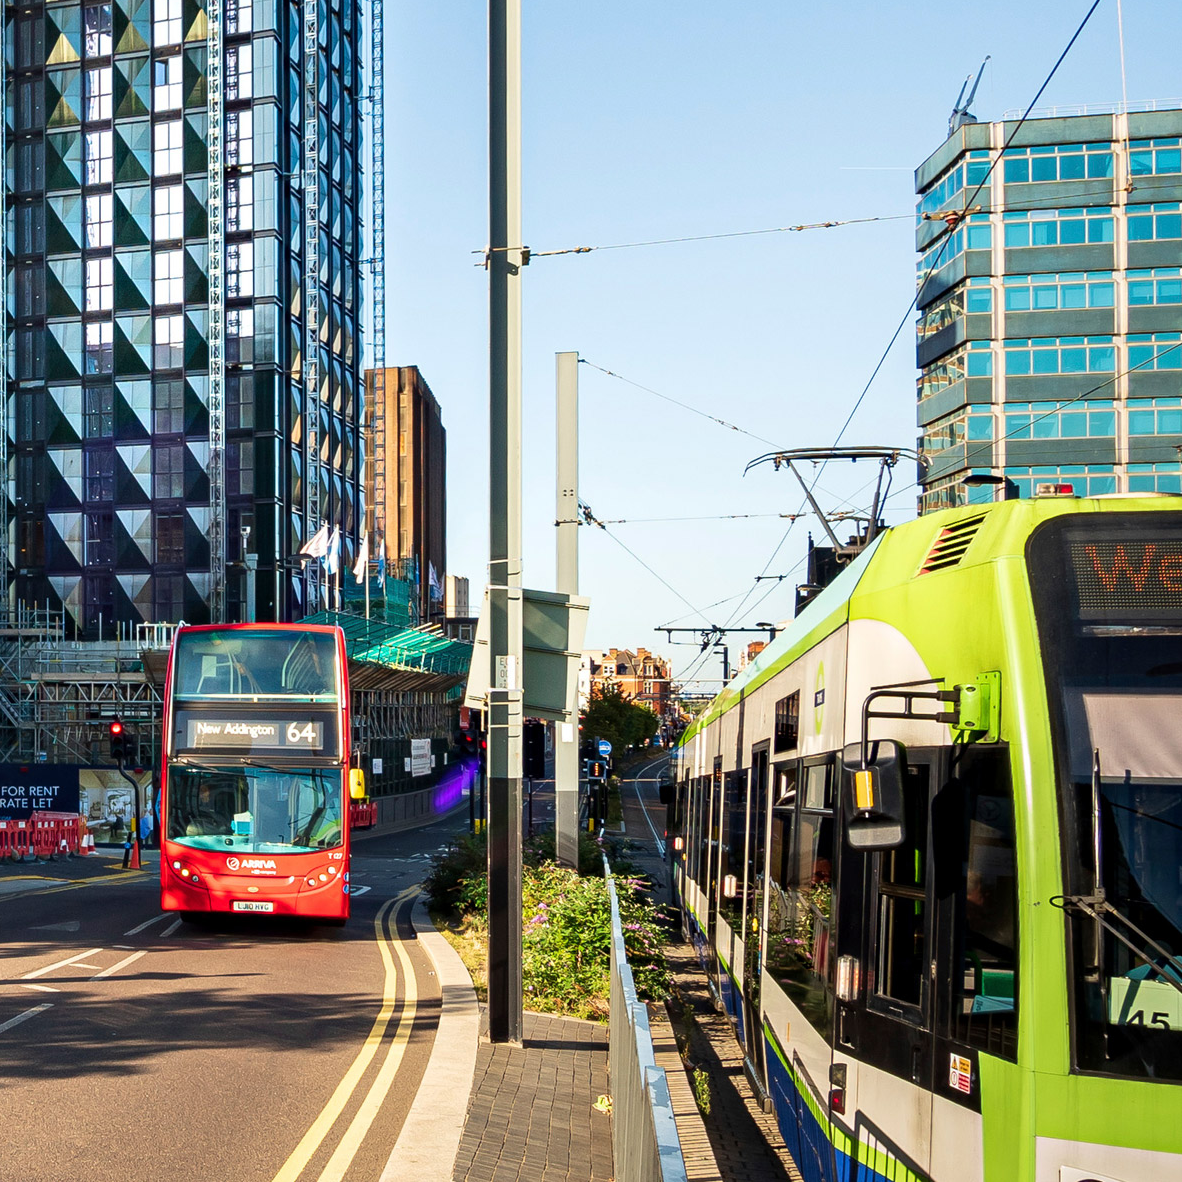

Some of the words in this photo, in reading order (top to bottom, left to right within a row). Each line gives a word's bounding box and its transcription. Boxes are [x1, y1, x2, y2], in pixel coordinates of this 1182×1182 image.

[197, 722, 221, 735] New
[224, 722, 275, 738] Addington
[287, 721, 317, 743] 64
[1, 786, 25, 796] FOR
[29, 786, 60, 796] RENT
[32, 798, 54, 808] LET
[241, 859, 277, 869] ARRIVA
